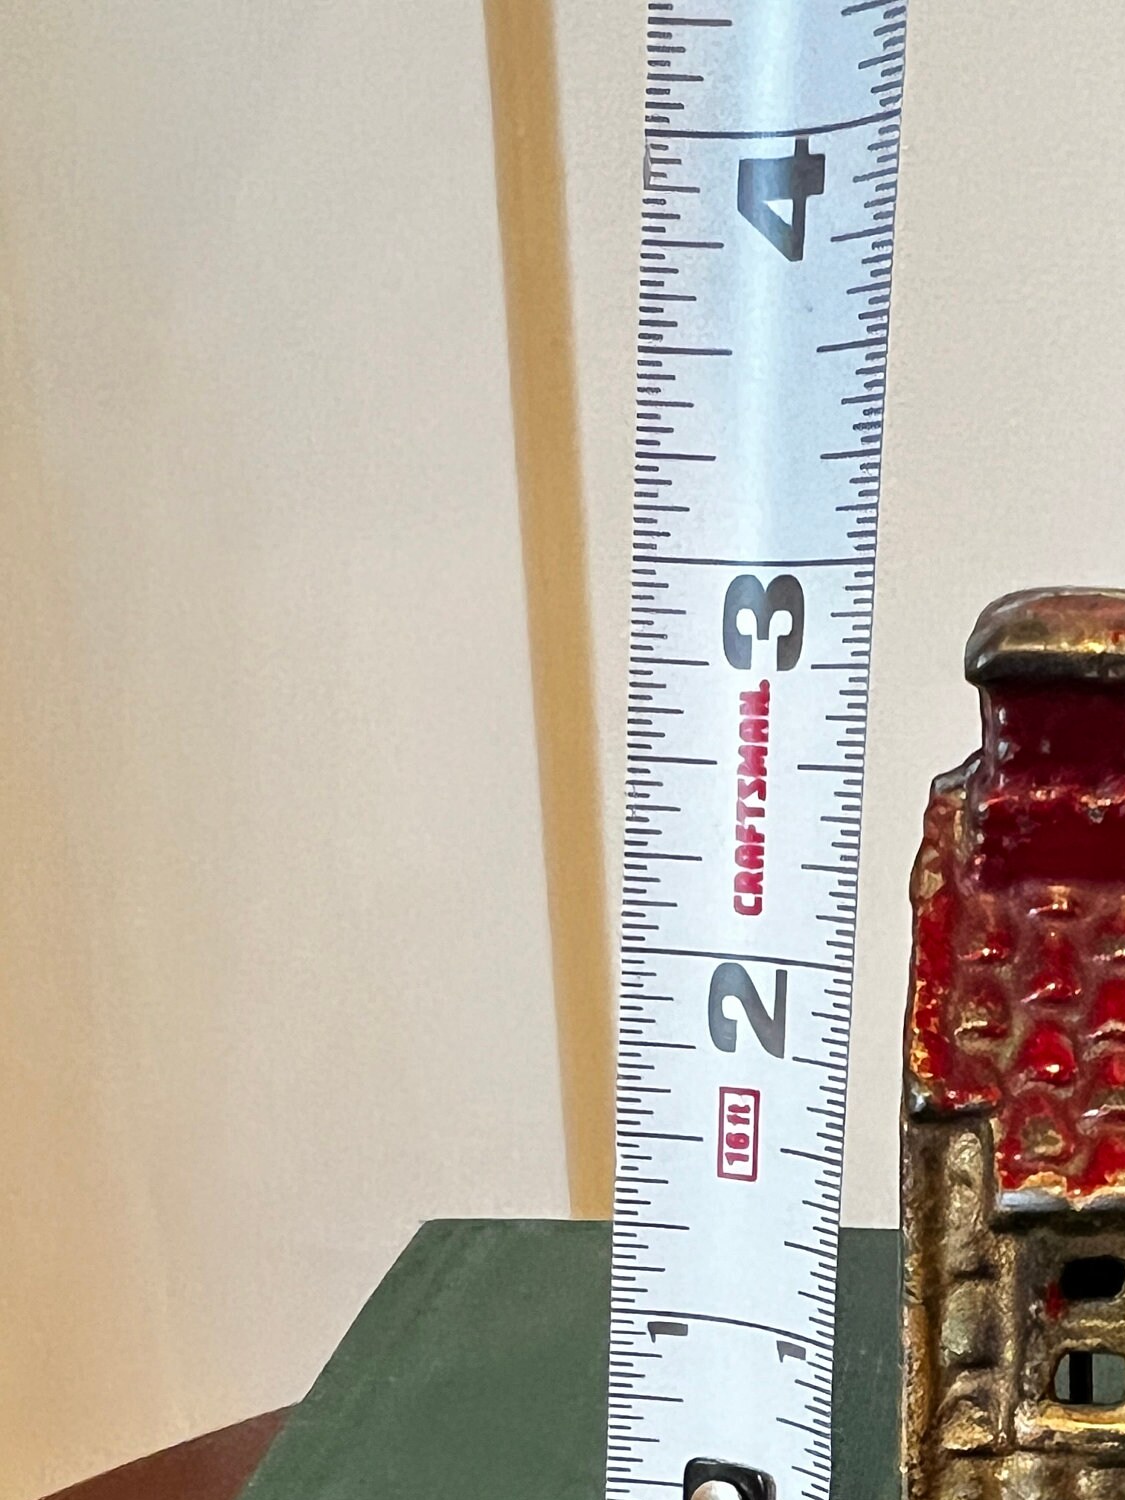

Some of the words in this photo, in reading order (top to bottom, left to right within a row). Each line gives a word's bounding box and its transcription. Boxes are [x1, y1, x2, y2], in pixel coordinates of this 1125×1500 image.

[737, 136, 825, 262] 4
[722, 573, 805, 672] 3
[733, 688, 770, 916] CRAFTSMAN
[708, 962, 788, 1060] 2
[724, 1132, 750, 1166] 16
[726, 1103, 752, 1127] ft
